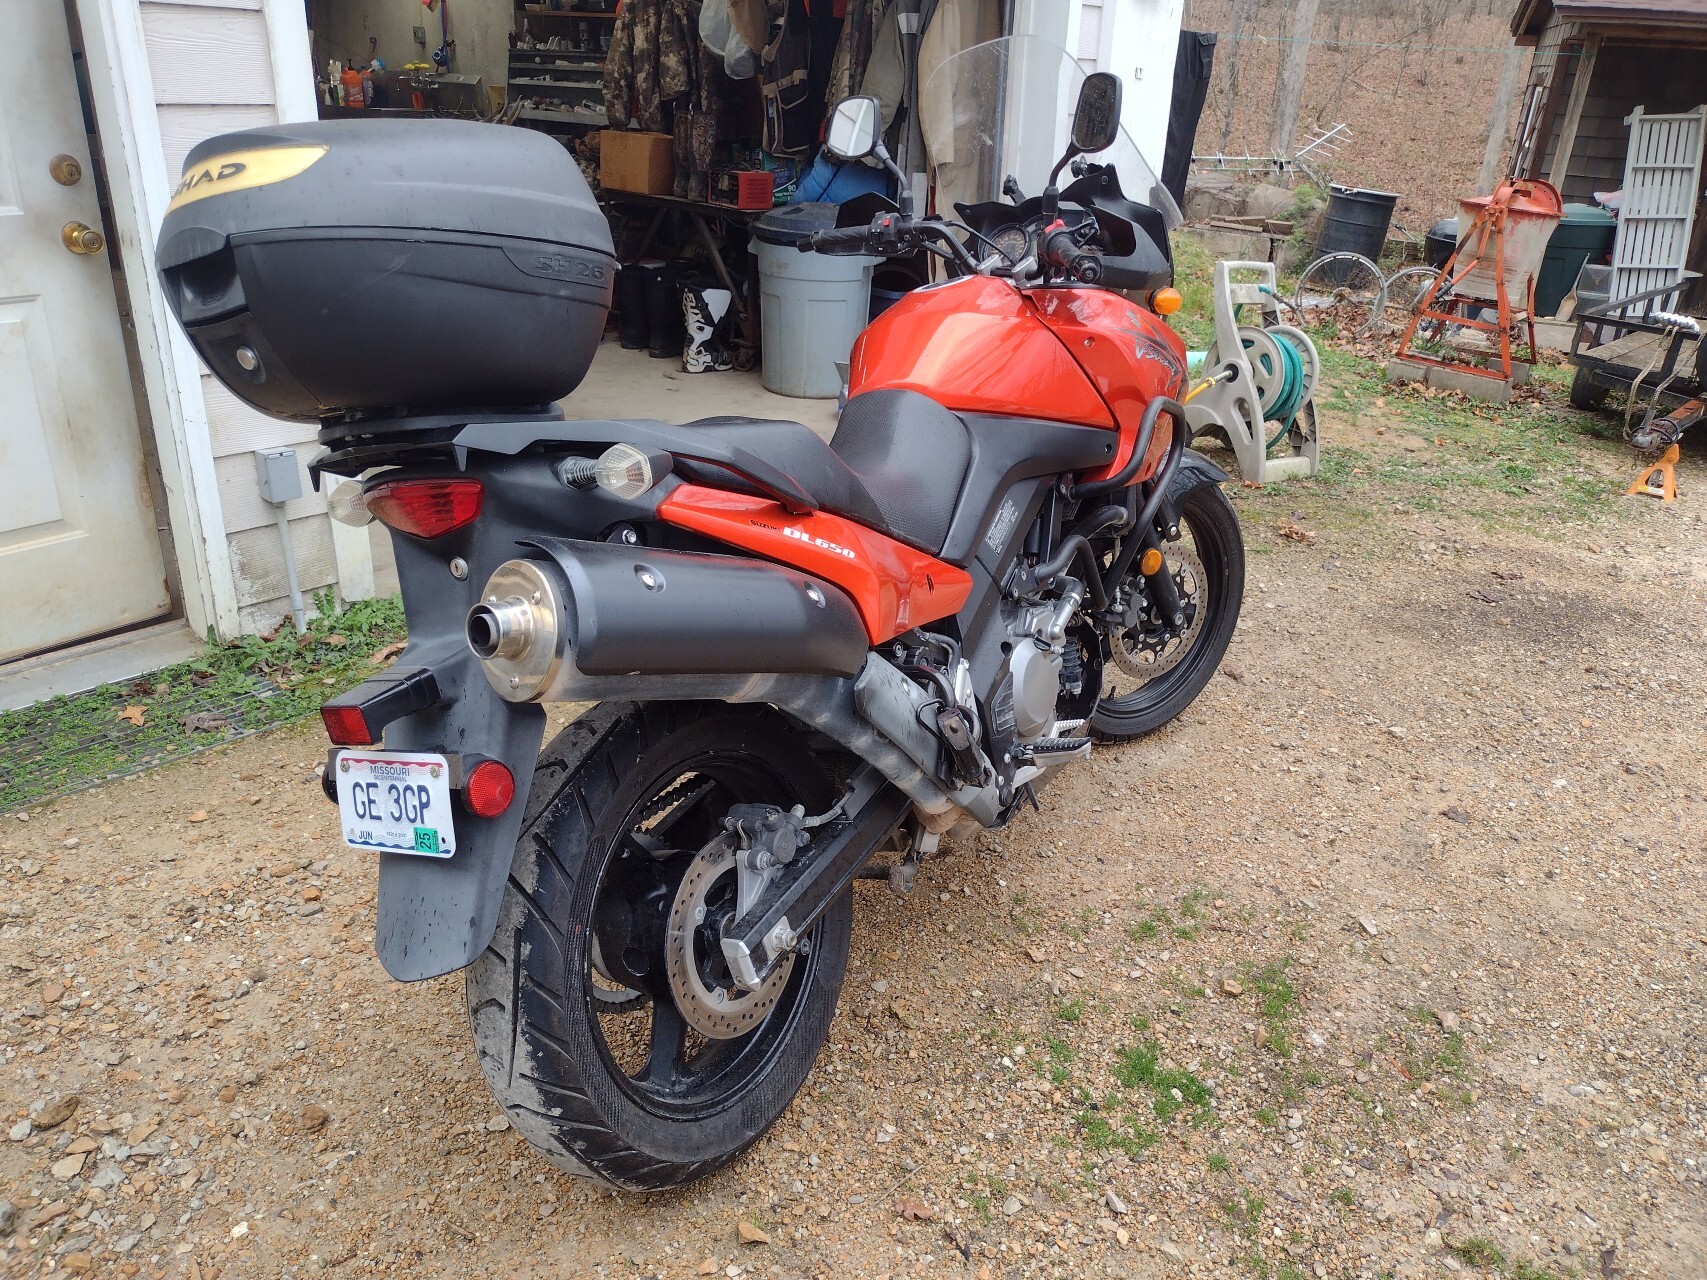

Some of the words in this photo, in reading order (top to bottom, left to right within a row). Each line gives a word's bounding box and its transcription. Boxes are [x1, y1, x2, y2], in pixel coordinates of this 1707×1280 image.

[783, 526, 855, 559] DL650
[370, 765, 410, 777] MISSOURI
[373, 774, 407, 783] BICENTENNIAL
[352, 781, 383, 821] GE
[387, 783, 431, 825] 3GP
[358, 830, 373, 841] JUN
[418, 832, 432, 850] 25
